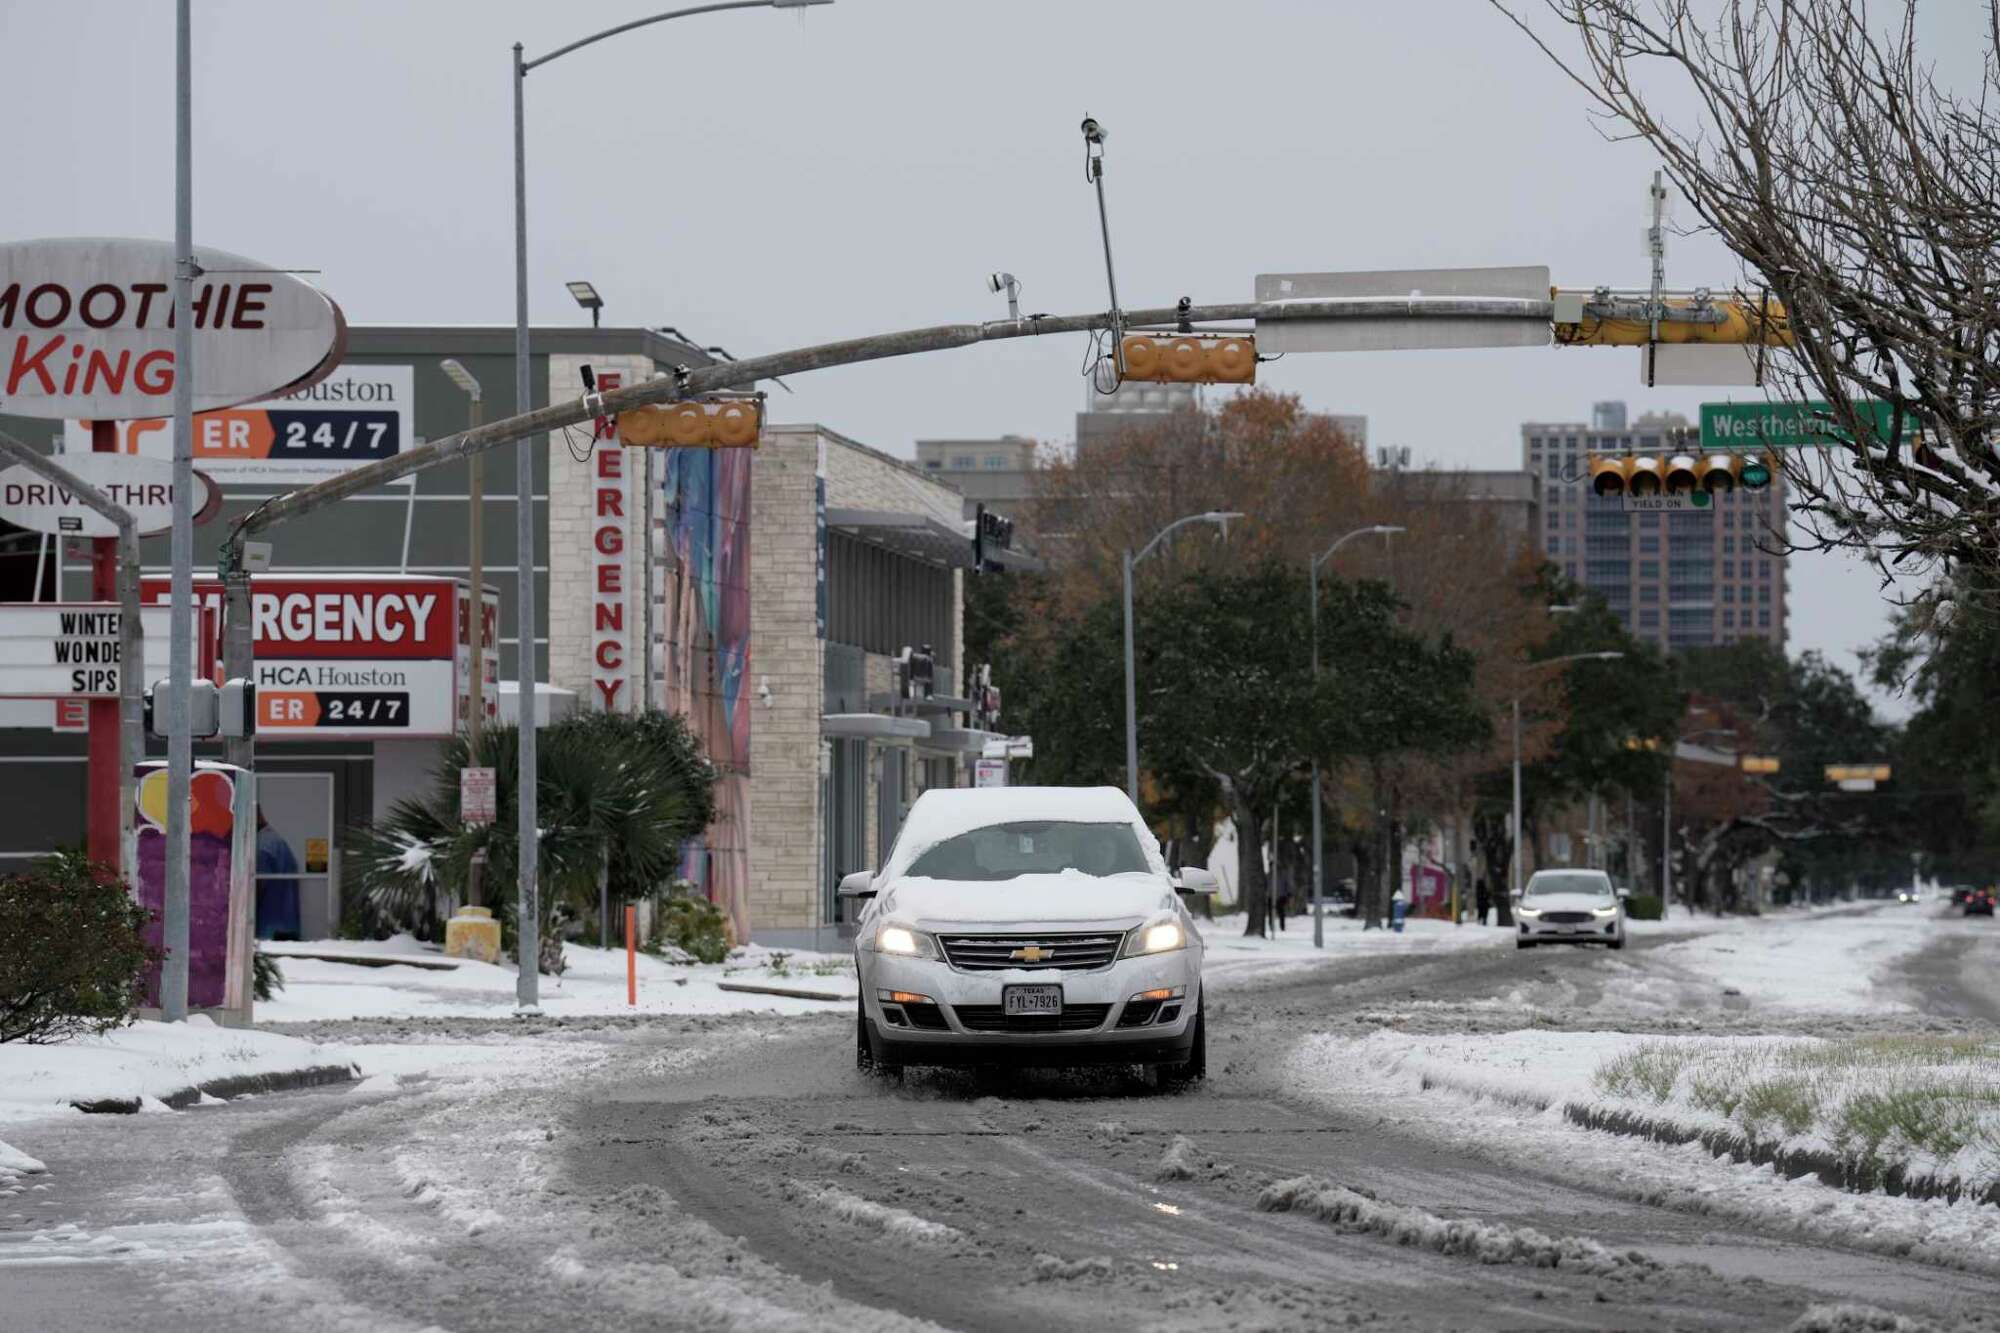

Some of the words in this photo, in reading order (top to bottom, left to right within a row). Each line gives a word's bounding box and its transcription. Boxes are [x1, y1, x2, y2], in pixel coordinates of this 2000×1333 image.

[286, 378, 394, 401] ouston
[203, 421, 250, 448] ER
[286, 421, 388, 449] 24/7
[6, 484, 88, 505] DRIV
[106, 484, 173, 506] THR
[1632, 500, 1662, 508] YIELD
[1666, 499, 1681, 508] ON
[61, 613, 122, 635] WINTE
[72, 670, 117, 692] SIPS
[260, 667, 312, 686] HCA
[316, 667, 407, 687] Houston
[269, 700, 304, 720] ER
[328, 700, 402, 720] 24/7
